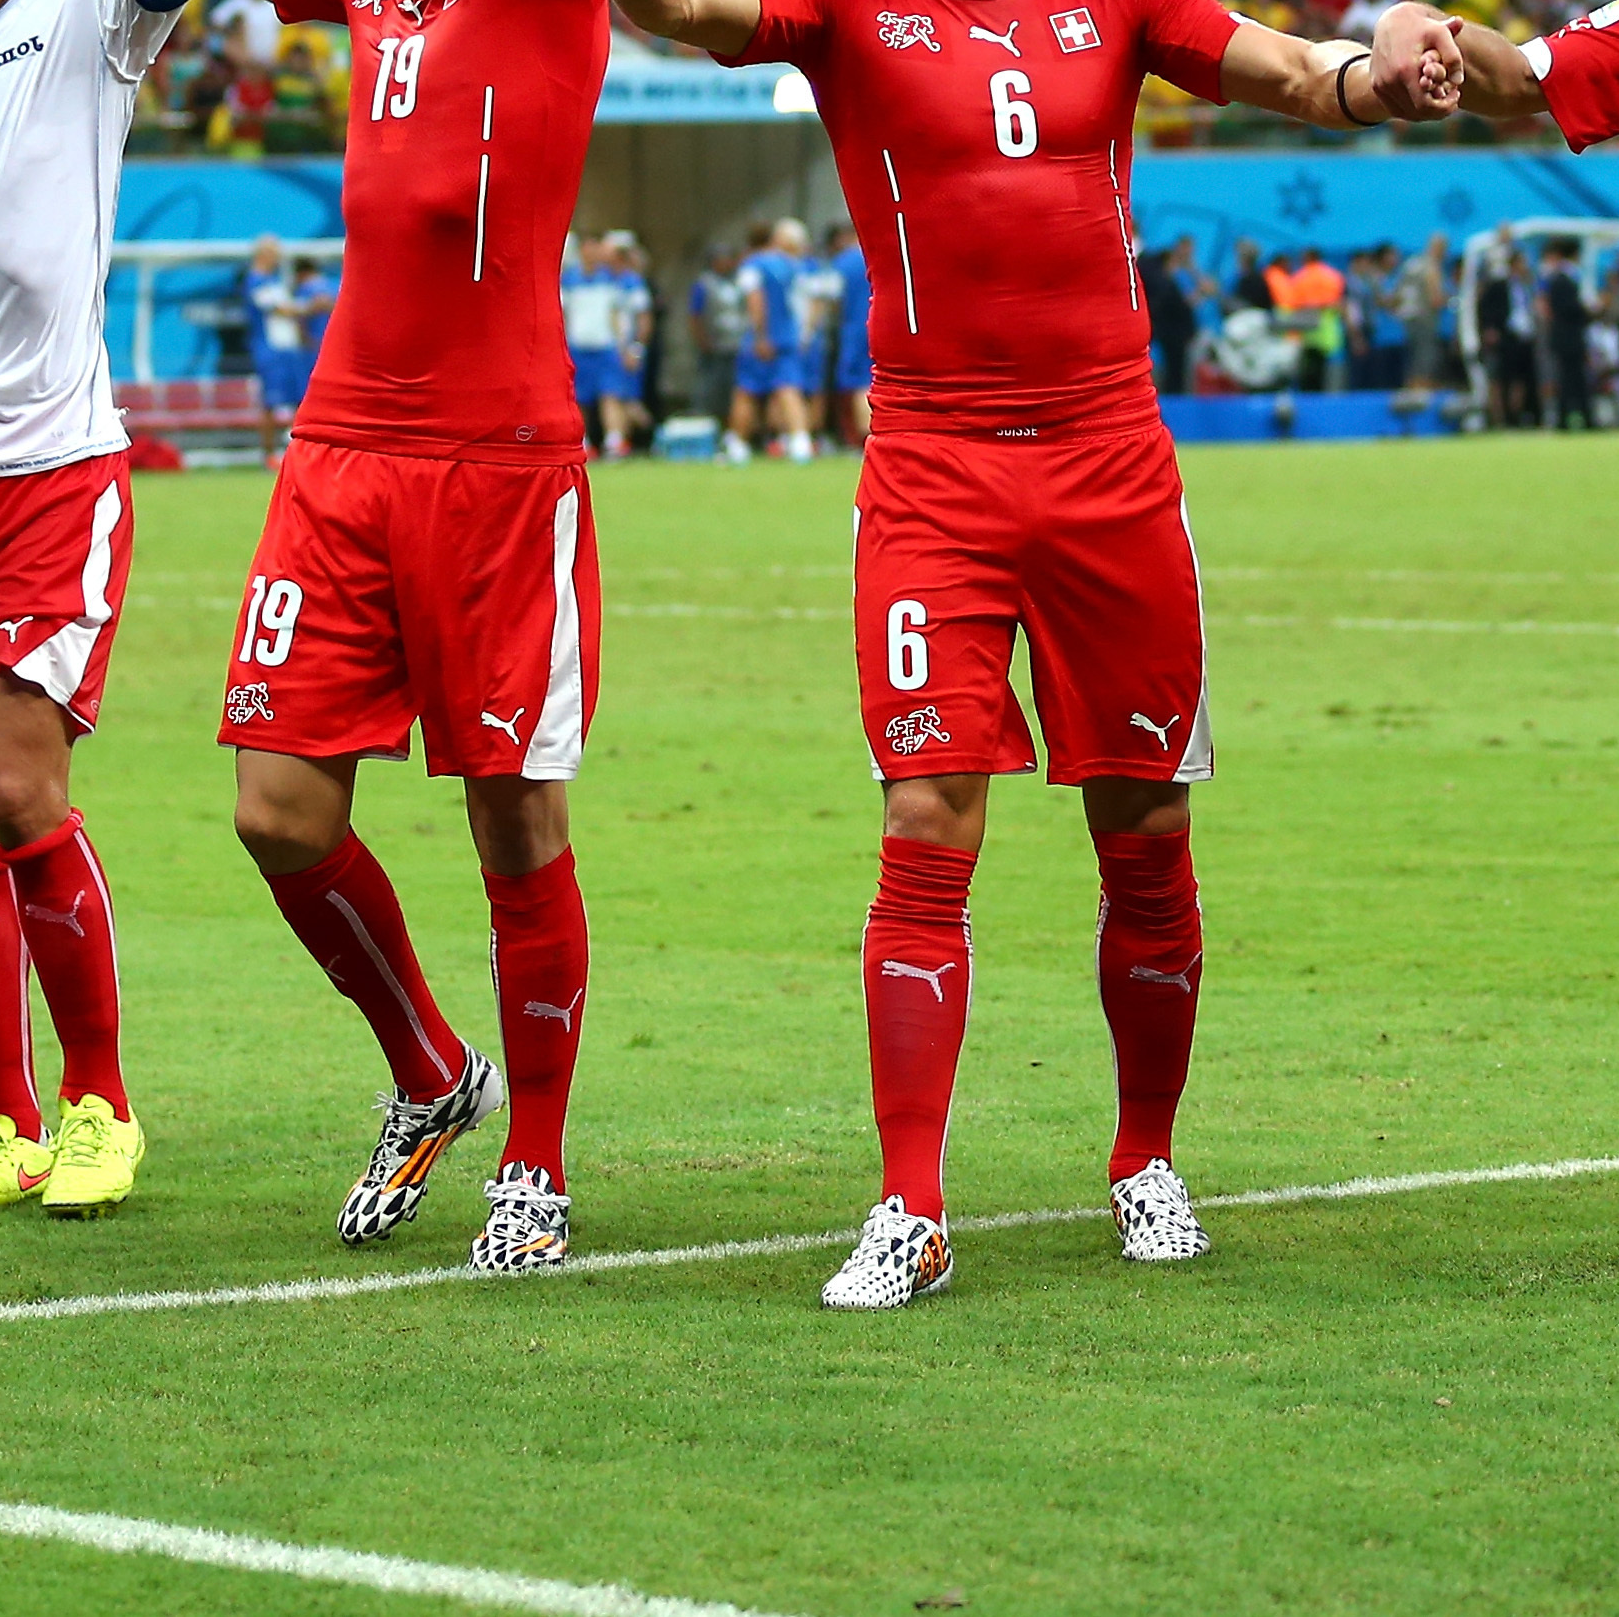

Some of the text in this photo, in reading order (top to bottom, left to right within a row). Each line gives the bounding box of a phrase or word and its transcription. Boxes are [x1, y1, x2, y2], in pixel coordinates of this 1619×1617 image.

[371, 34, 425, 121] 19
[989, 69, 1038, 158] 6
[238, 575, 303, 667] 19
[888, 599, 929, 691] 6
